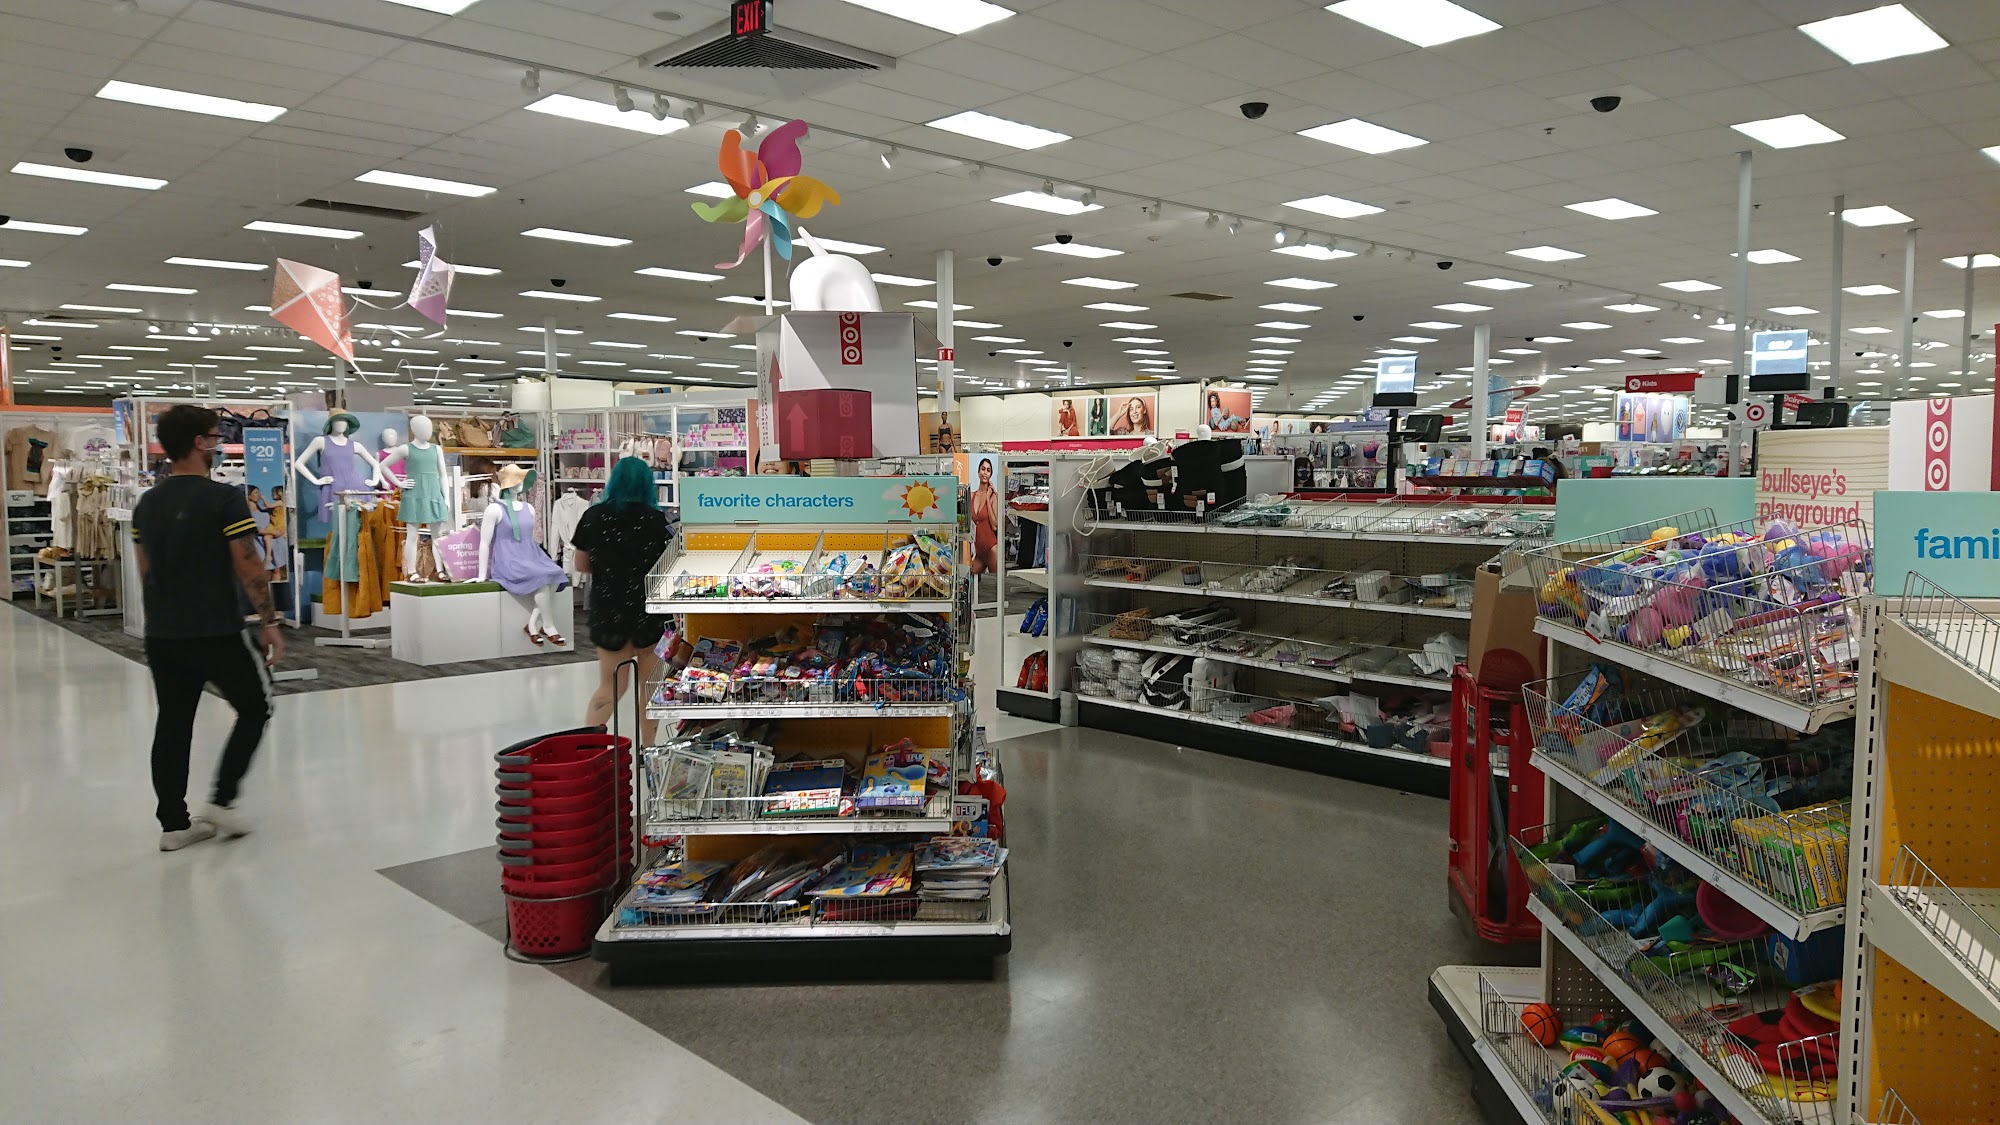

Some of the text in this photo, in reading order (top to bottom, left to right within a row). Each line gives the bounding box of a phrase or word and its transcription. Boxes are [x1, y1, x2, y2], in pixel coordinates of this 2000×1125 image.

[736, 0, 760, 35] EXIT
[250, 445, 275, 458] $20
[1762, 467, 1847, 499] bullseye's
[698, 493, 854, 508] favorite characters
[1760, 496, 1860, 528] playground
[447, 542, 473, 551] spring
[1914, 528, 2000, 559] fami
[961, 806, 977, 815] FLIP
